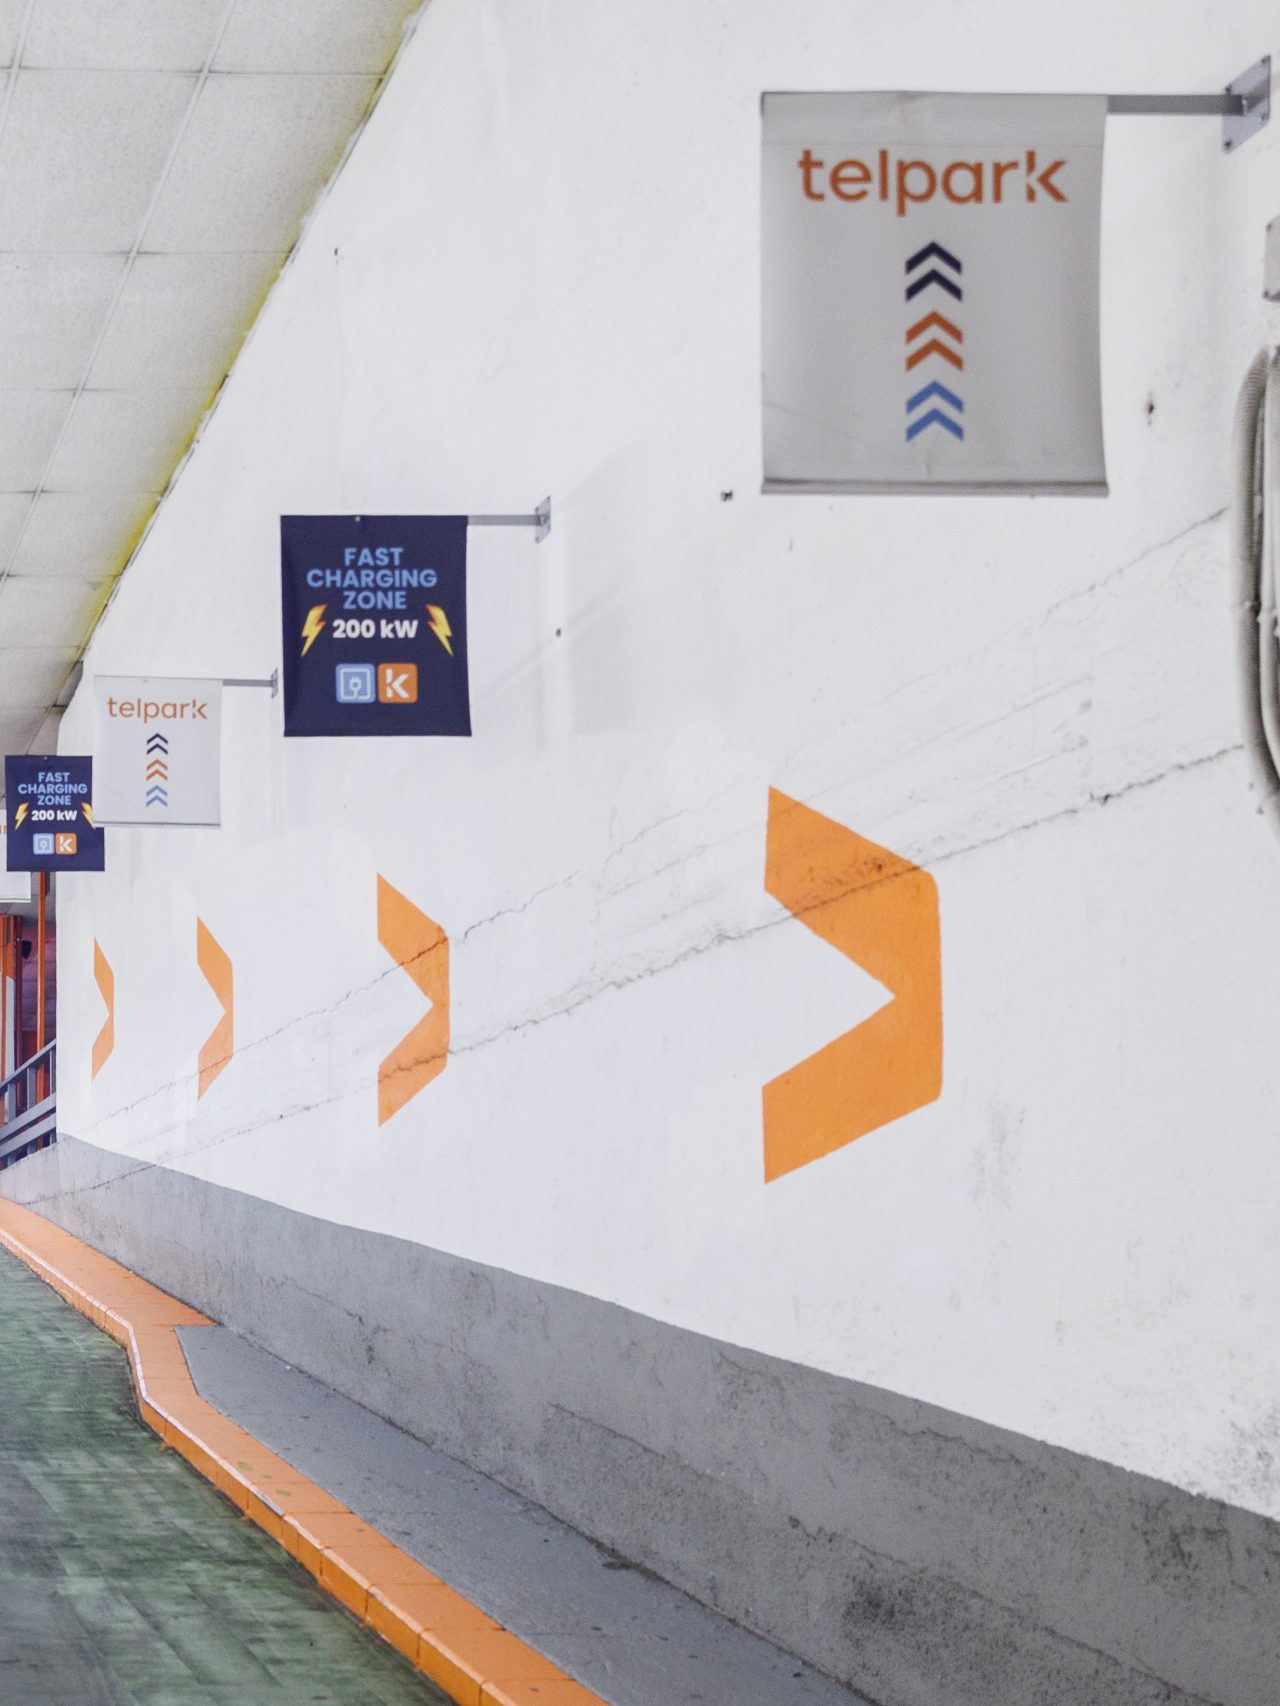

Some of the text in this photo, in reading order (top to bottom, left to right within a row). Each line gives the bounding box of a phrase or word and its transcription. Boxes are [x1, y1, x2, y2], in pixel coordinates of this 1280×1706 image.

[797, 149, 1069, 217] telpark
[344, 547, 404, 567] FAST
[306, 568, 438, 588] CHARGING
[343, 590, 407, 610] ZONE
[332, 619, 419, 639] 200 kW
[107, 697, 208, 724] telpark
[38, 771, 71, 783] FAST
[17, 783, 88, 795] CHARGING
[37, 794, 72, 806] ZONE
[31, 809, 78, 821] 200 kW
